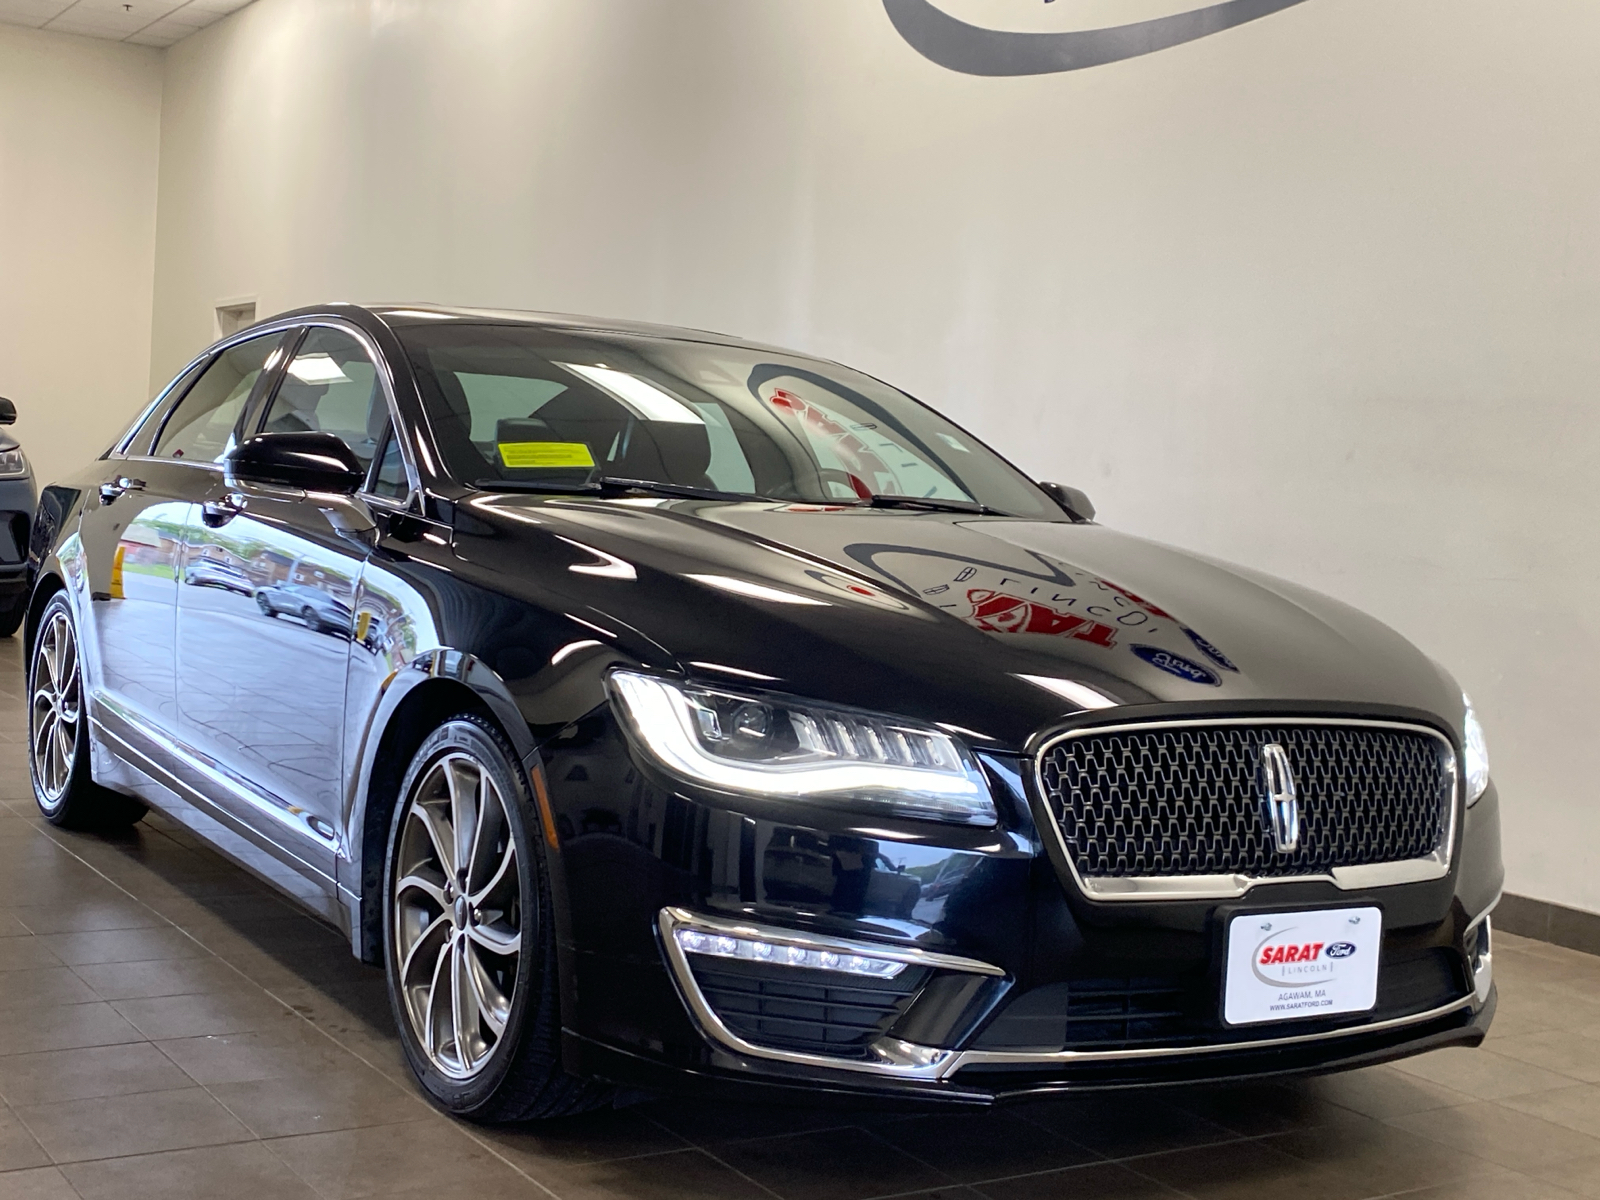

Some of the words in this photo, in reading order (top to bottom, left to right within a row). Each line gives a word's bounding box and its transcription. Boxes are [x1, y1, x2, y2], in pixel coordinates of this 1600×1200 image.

[1259, 942, 1325, 965] SARAT
[1327, 942, 1354, 958] Ford
[1287, 964, 1328, 975] LINCOLN
[1277, 991, 1313, 1001] AGAWAM,
[1315, 989, 1326, 998] MA
[1269, 999, 1334, 1011] WWW.SARATFORD.COM
